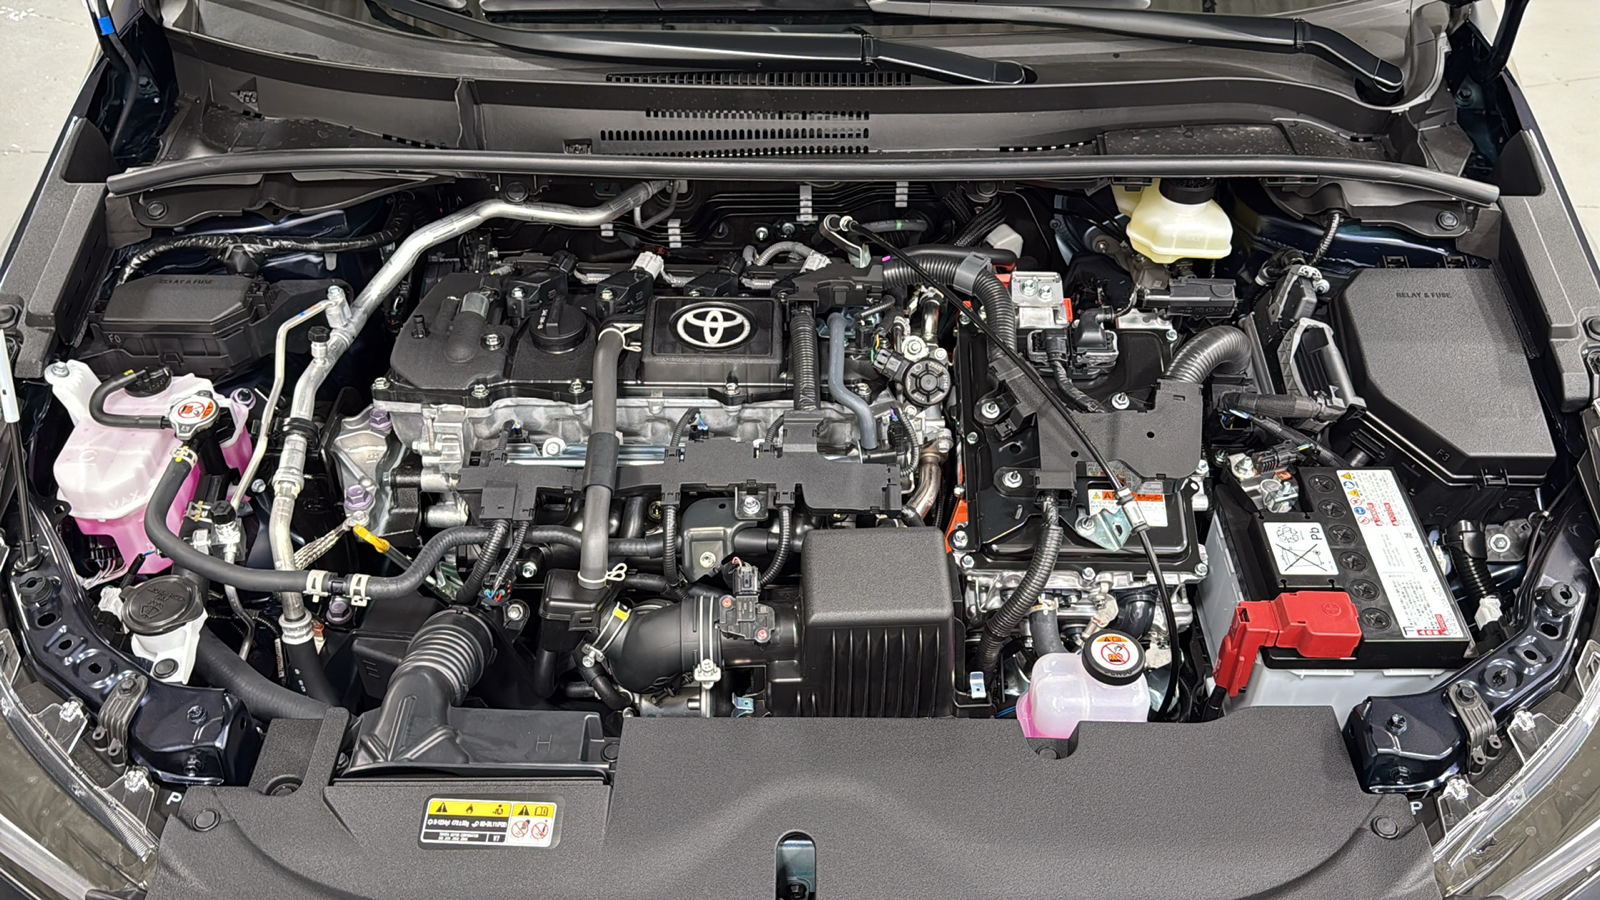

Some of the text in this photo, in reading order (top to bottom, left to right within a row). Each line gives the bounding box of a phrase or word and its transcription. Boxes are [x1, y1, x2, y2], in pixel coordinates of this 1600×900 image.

[1436, 448, 1450, 462] F3
[1309, 526, 1322, 541] Pb
[535, 734, 553, 752] H
[166, 791, 182, 806] P
[1409, 801, 1424, 815] P
